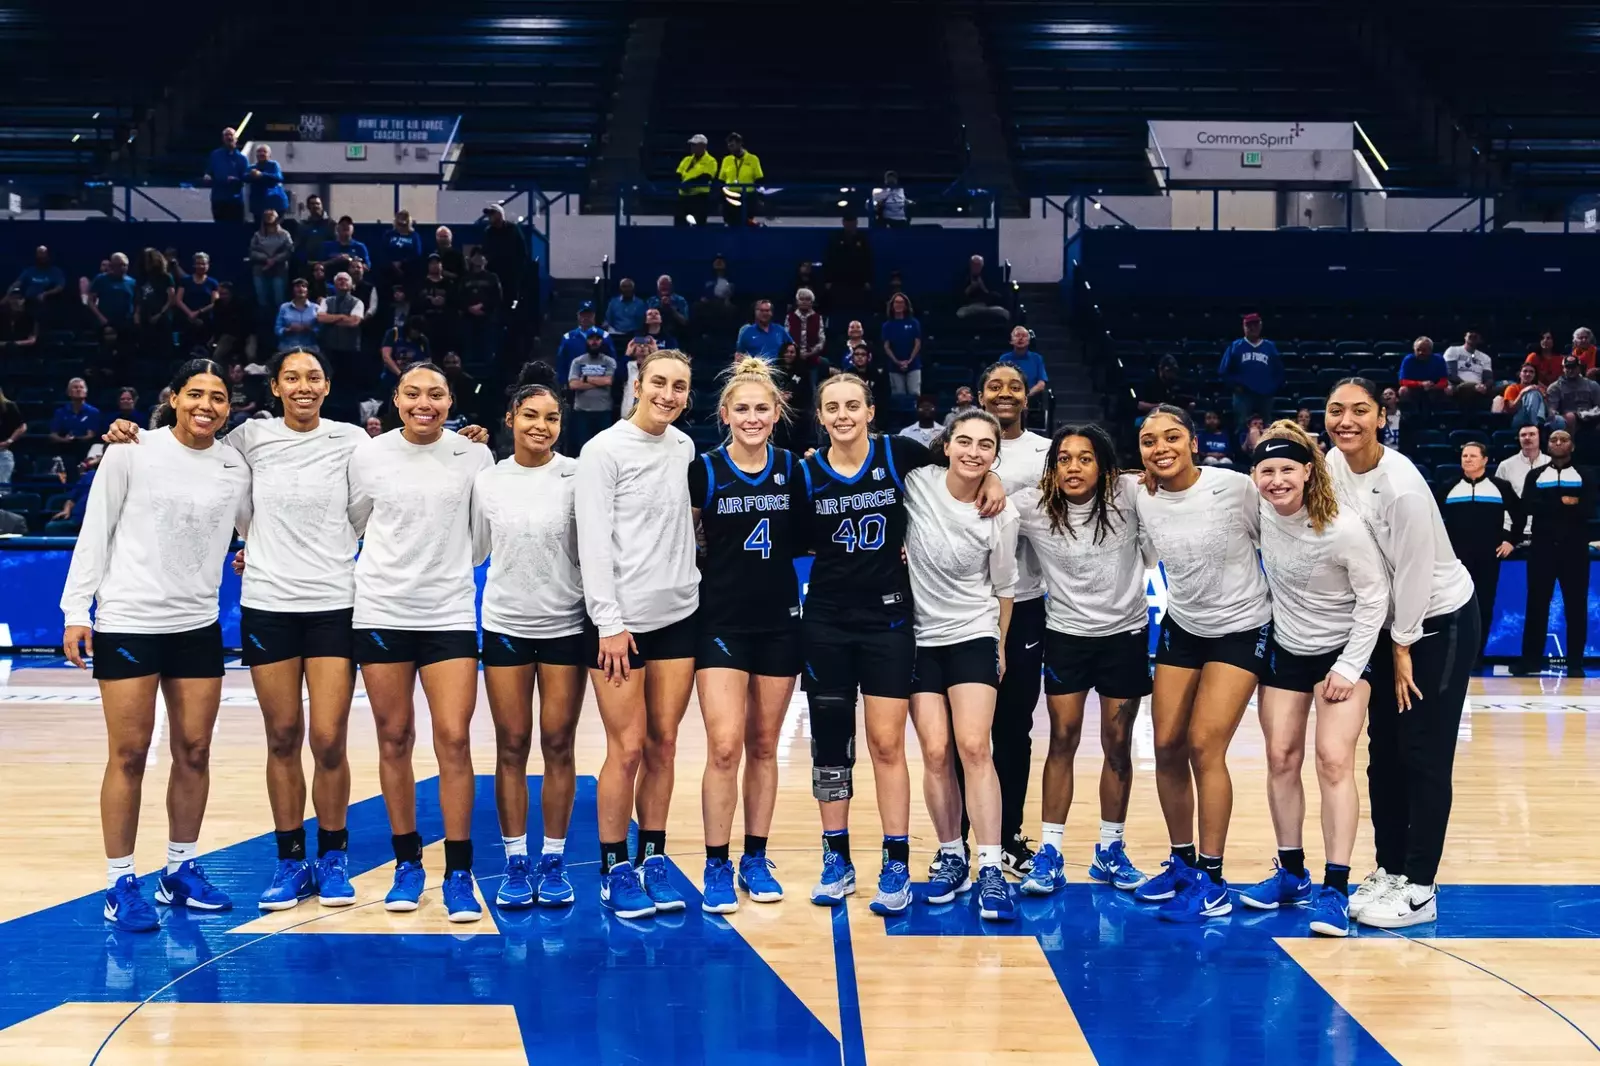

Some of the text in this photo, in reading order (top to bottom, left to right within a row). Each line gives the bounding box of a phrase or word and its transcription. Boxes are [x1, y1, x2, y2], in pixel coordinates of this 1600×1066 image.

[391, 120, 405, 130] THE
[406, 120, 419, 130] AIR
[422, 120, 444, 131] FORCE
[374, 131, 405, 140] COACHES
[1197, 131, 1294, 148] CommonSpirit
[1241, 352, 1268, 365] AIR FORCE
[717, 495, 790, 514] AIR FORCE
[816, 488, 896, 514] AIR FORCE
[744, 518, 772, 559] 4
[832, 513, 887, 553] 40
